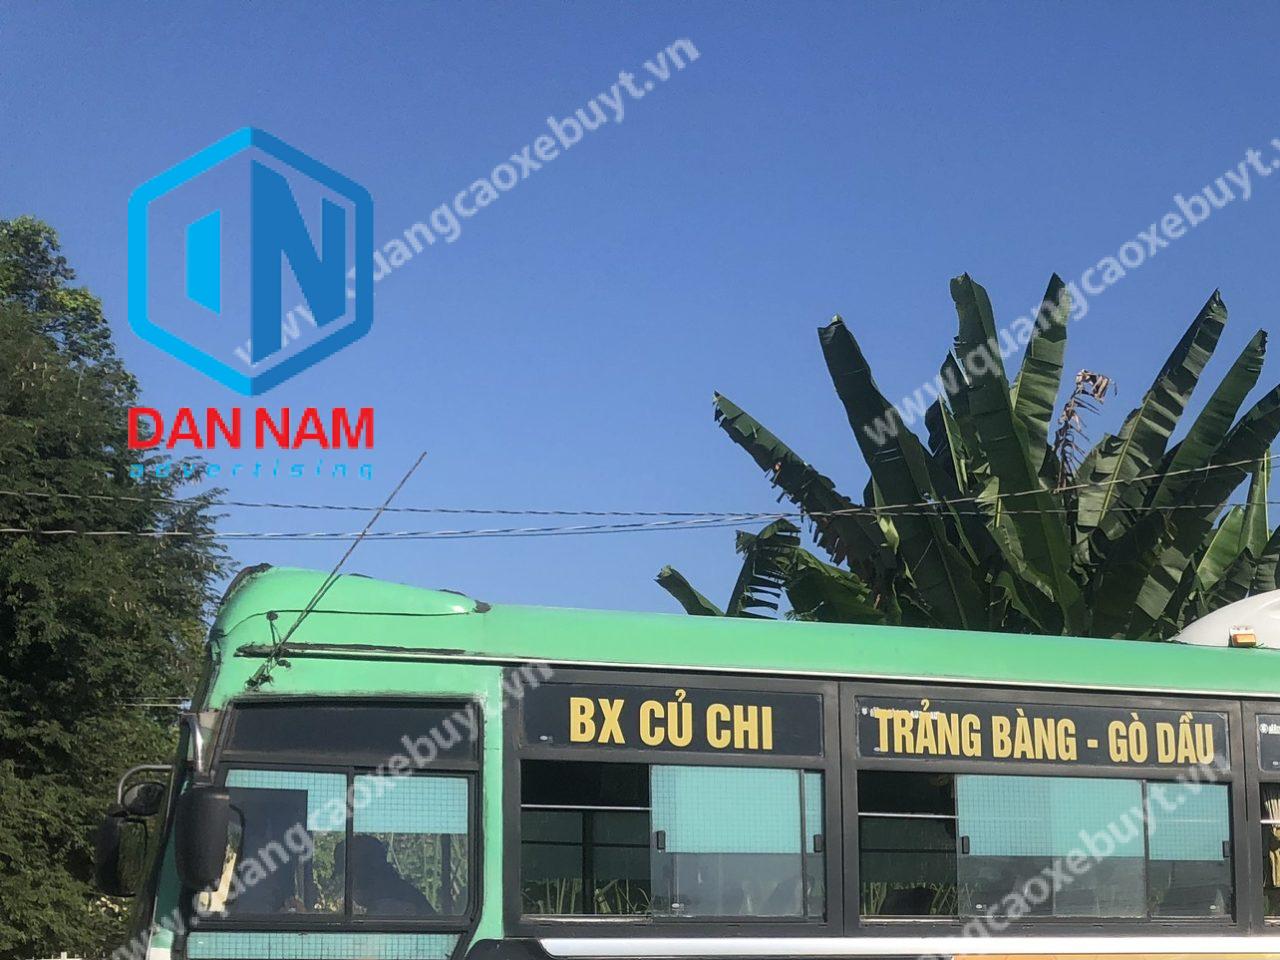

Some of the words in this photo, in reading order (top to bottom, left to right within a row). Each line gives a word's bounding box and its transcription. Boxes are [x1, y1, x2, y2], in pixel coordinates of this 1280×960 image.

[570, 696, 626, 744] BX
[639, 689, 693, 748] CỦ
[706, 703, 773, 750] CHI
[874, 699, 981, 757] TRẢNG
[991, 708, 1078, 761] BÀNG
[1107, 712, 1147, 763] GÒ
[1156, 712, 1214, 764] DẦU
